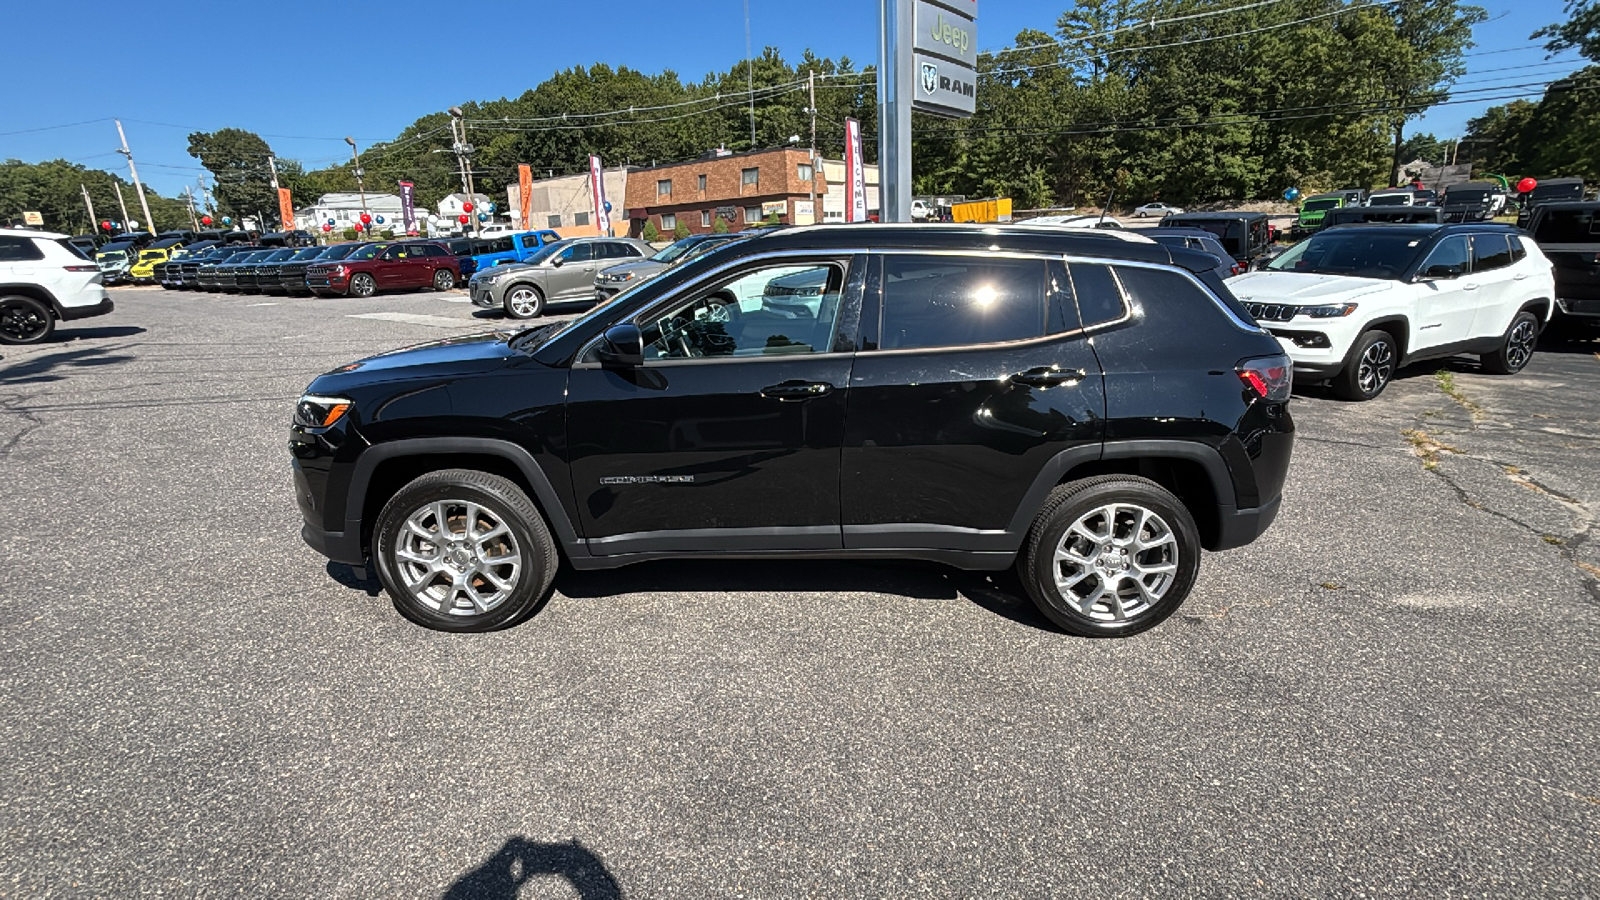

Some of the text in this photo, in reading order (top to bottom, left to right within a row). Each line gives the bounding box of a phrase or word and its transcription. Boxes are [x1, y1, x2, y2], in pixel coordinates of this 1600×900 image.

[931, 13, 969, 55] Jeep
[940, 75, 974, 98] RAM
[853, 134, 863, 209] WELCOME
